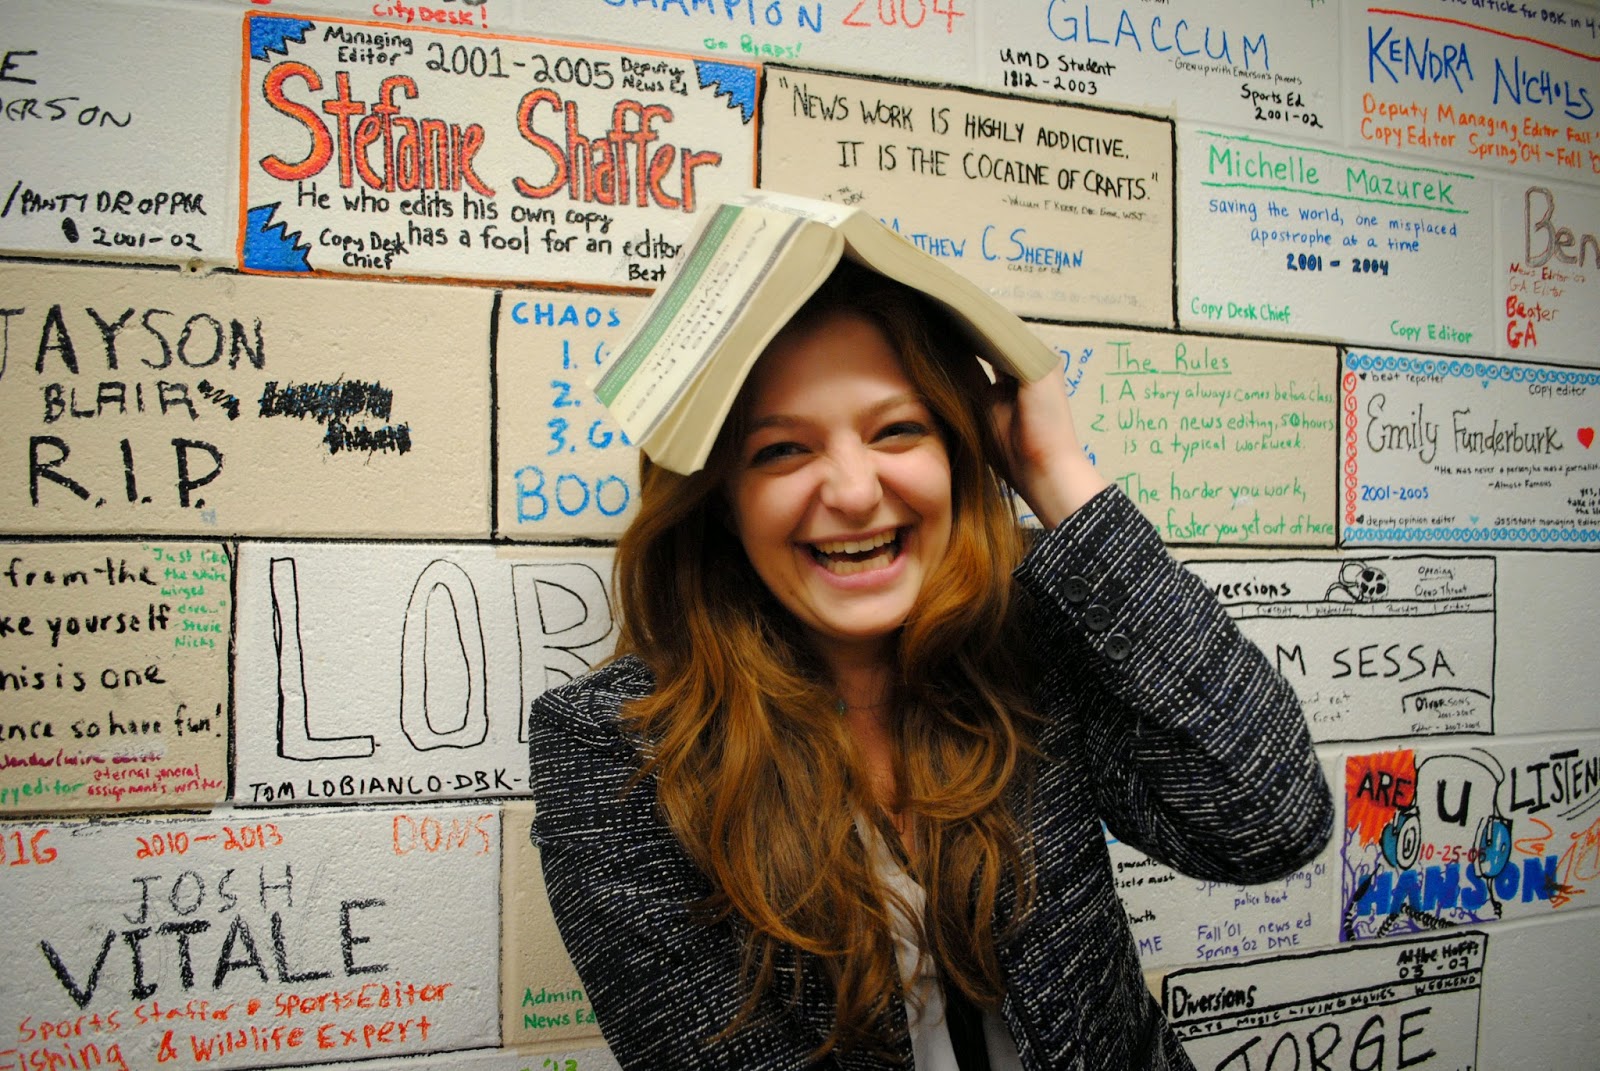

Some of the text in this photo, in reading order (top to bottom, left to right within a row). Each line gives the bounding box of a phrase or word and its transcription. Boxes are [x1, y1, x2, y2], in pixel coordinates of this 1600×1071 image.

[1541, 10, 1566, 24] DBK
[1570, 18, 1581, 28] in
[323, 26, 413, 55] Managing
[1047, 0, 1270, 70] GLACCUM
[338, 46, 401, 65] Editor
[621, 57, 685, 78] Deputy
[1058, 53, 1117, 77] Student
[1368, 26, 1474, 94] KENDRA
[622, 76, 689, 96] News Ed
[1241, 83, 1305, 108] Sports Ed
[860, 100, 915, 133] WORK
[931, 107, 951, 135] IS
[964, 113, 1024, 142] HIGHLY
[1037, 122, 1129, 160] ADDICTIVE.
[1254, 107, 1324, 129] 2001-02
[1361, 118, 1456, 147] Copy Editor
[1362, 92, 1591, 144] Deputy Managing Editor Fall
[512, 87, 723, 213] Shaffer
[1557, 149, 1582, 169] Fall
[837, 141, 864, 167] IT
[878, 145, 897, 172] IS
[906, 147, 951, 177] THE
[963, 152, 1048, 186] COCAINE
[1057, 168, 1080, 191] OF
[1208, 144, 1455, 205] Michelle Mazurek
[298, 181, 614, 234] He who edits his copy
[1208, 199, 1457, 237] saving the world, one misplaced
[319, 228, 409, 255] Copy Desk
[408, 221, 683, 260] has a fool for an editor
[982, 225, 1083, 270] C. SHEEHAN
[1250, 227, 1420, 252] apostrophe at a time
[342, 251, 396, 270] Chief
[628, 264, 667, 282] Beat
[1287, 254, 1323, 271] 2001
[511, 301, 621, 328] CHAOS
[1191, 296, 1292, 324] Copy Desk Chief
[1390, 320, 1473, 344] Copy Editor
[1506, 319, 1537, 349] GA
[1105, 341, 1229, 371] The Rules
[1371, 371, 1445, 385] beat reporter
[1556, 383, 1587, 396] editor
[42, 380, 200, 422] BLAIR
[552, 380, 581, 409] 2.
[1100, 384, 1109, 404] 1.
[1118, 379, 1135, 401] A
[1144, 381, 1180, 409] story
[1185, 382, 1231, 408] always
[1273, 380, 1306, 402] before
[547, 417, 576, 456] 3.
[1117, 409, 1168, 432] When
[1180, 414, 1223, 430] news
[1227, 412, 1280, 439] editing,
[1302, 414, 1335, 432] hours
[1367, 392, 1564, 465] Emily Funderburk
[1123, 433, 1226, 464] is a typical
[1115, 471, 1307, 510] The harder you work,
[1361, 485, 1430, 501] 2001-2005
[1165, 508, 1335, 544] faster you get out of here
[1366, 515, 1456, 528] deputy opinion editor
[1494, 517, 1576, 528] assistant managing
[4, 557, 157, 587] from the
[47, 603, 171, 648] yourself
[1332, 643, 1456, 682] SESSA
[56, 663, 167, 692] is one
[71, 719, 101, 739] so
[108, 710, 162, 736] have
[250, 781, 295, 802] TOM
[1357, 771, 1412, 809] ARE
[122, 864, 293, 925] JOSH
[1264, 891, 1288, 904] beat
[1258, 912, 1312, 934] news ed
[41, 898, 389, 1009] VITALE
[1267, 933, 1300, 949] DME
[522, 987, 582, 1008] Admin
[318, 1015, 432, 1050] Expert
[523, 1012, 571, 1031] News
